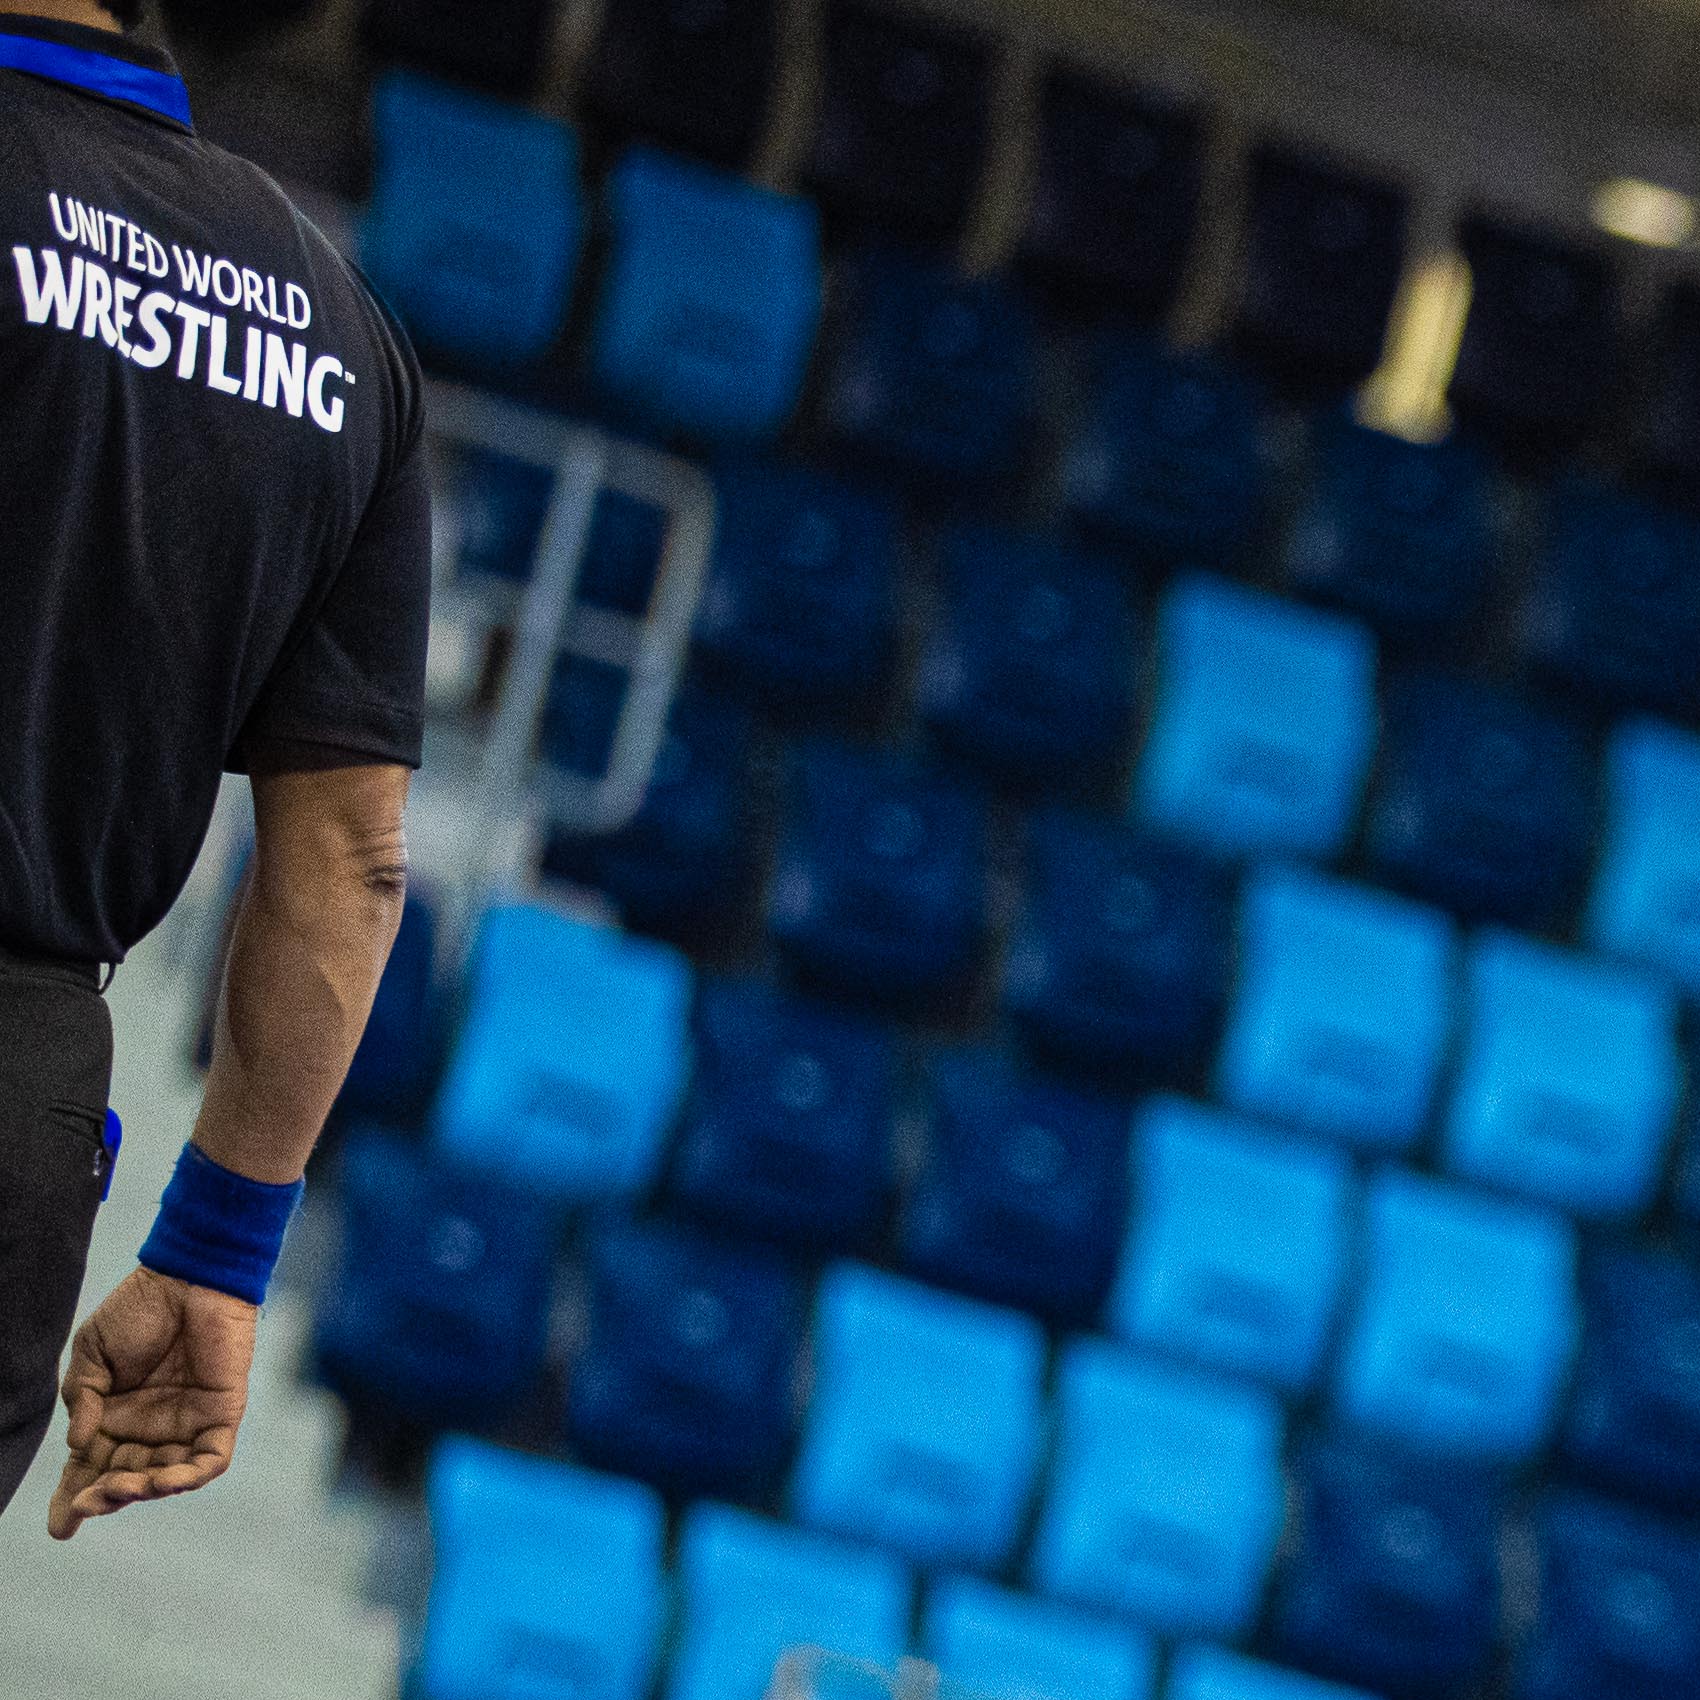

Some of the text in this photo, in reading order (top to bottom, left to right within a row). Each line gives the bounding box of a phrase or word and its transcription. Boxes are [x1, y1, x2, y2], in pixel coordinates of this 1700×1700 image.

[12, 246, 345, 432] WRESTLING
[48, 192, 312, 331] UNITED WORLD
